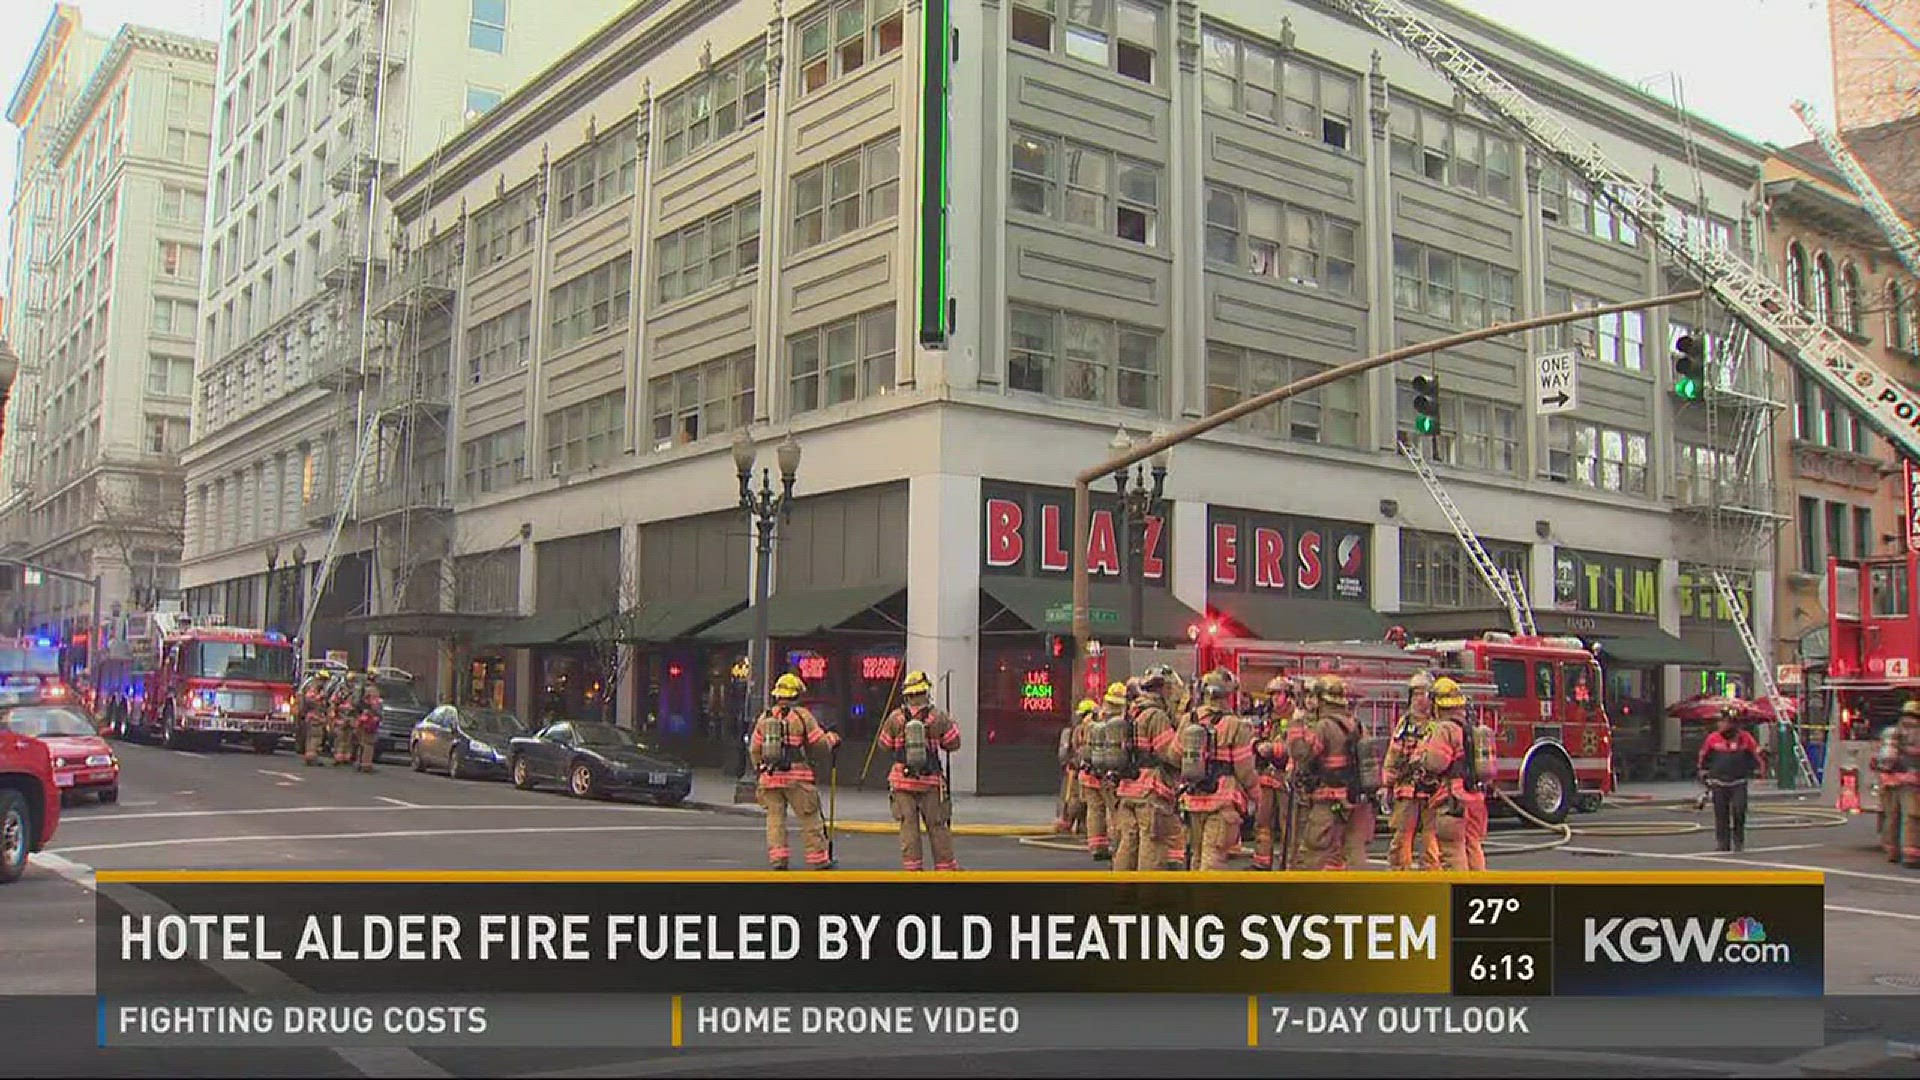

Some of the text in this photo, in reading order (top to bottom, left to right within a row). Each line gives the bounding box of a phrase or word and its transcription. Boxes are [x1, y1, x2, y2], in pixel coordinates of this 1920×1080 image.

[1541, 356, 1569, 373] ONE
[1541, 373, 1570, 389] WAY
[1028, 670, 1049, 684] LIVE
[1024, 685, 1053, 698] CASH
[1023, 697, 1053, 712] POKER
